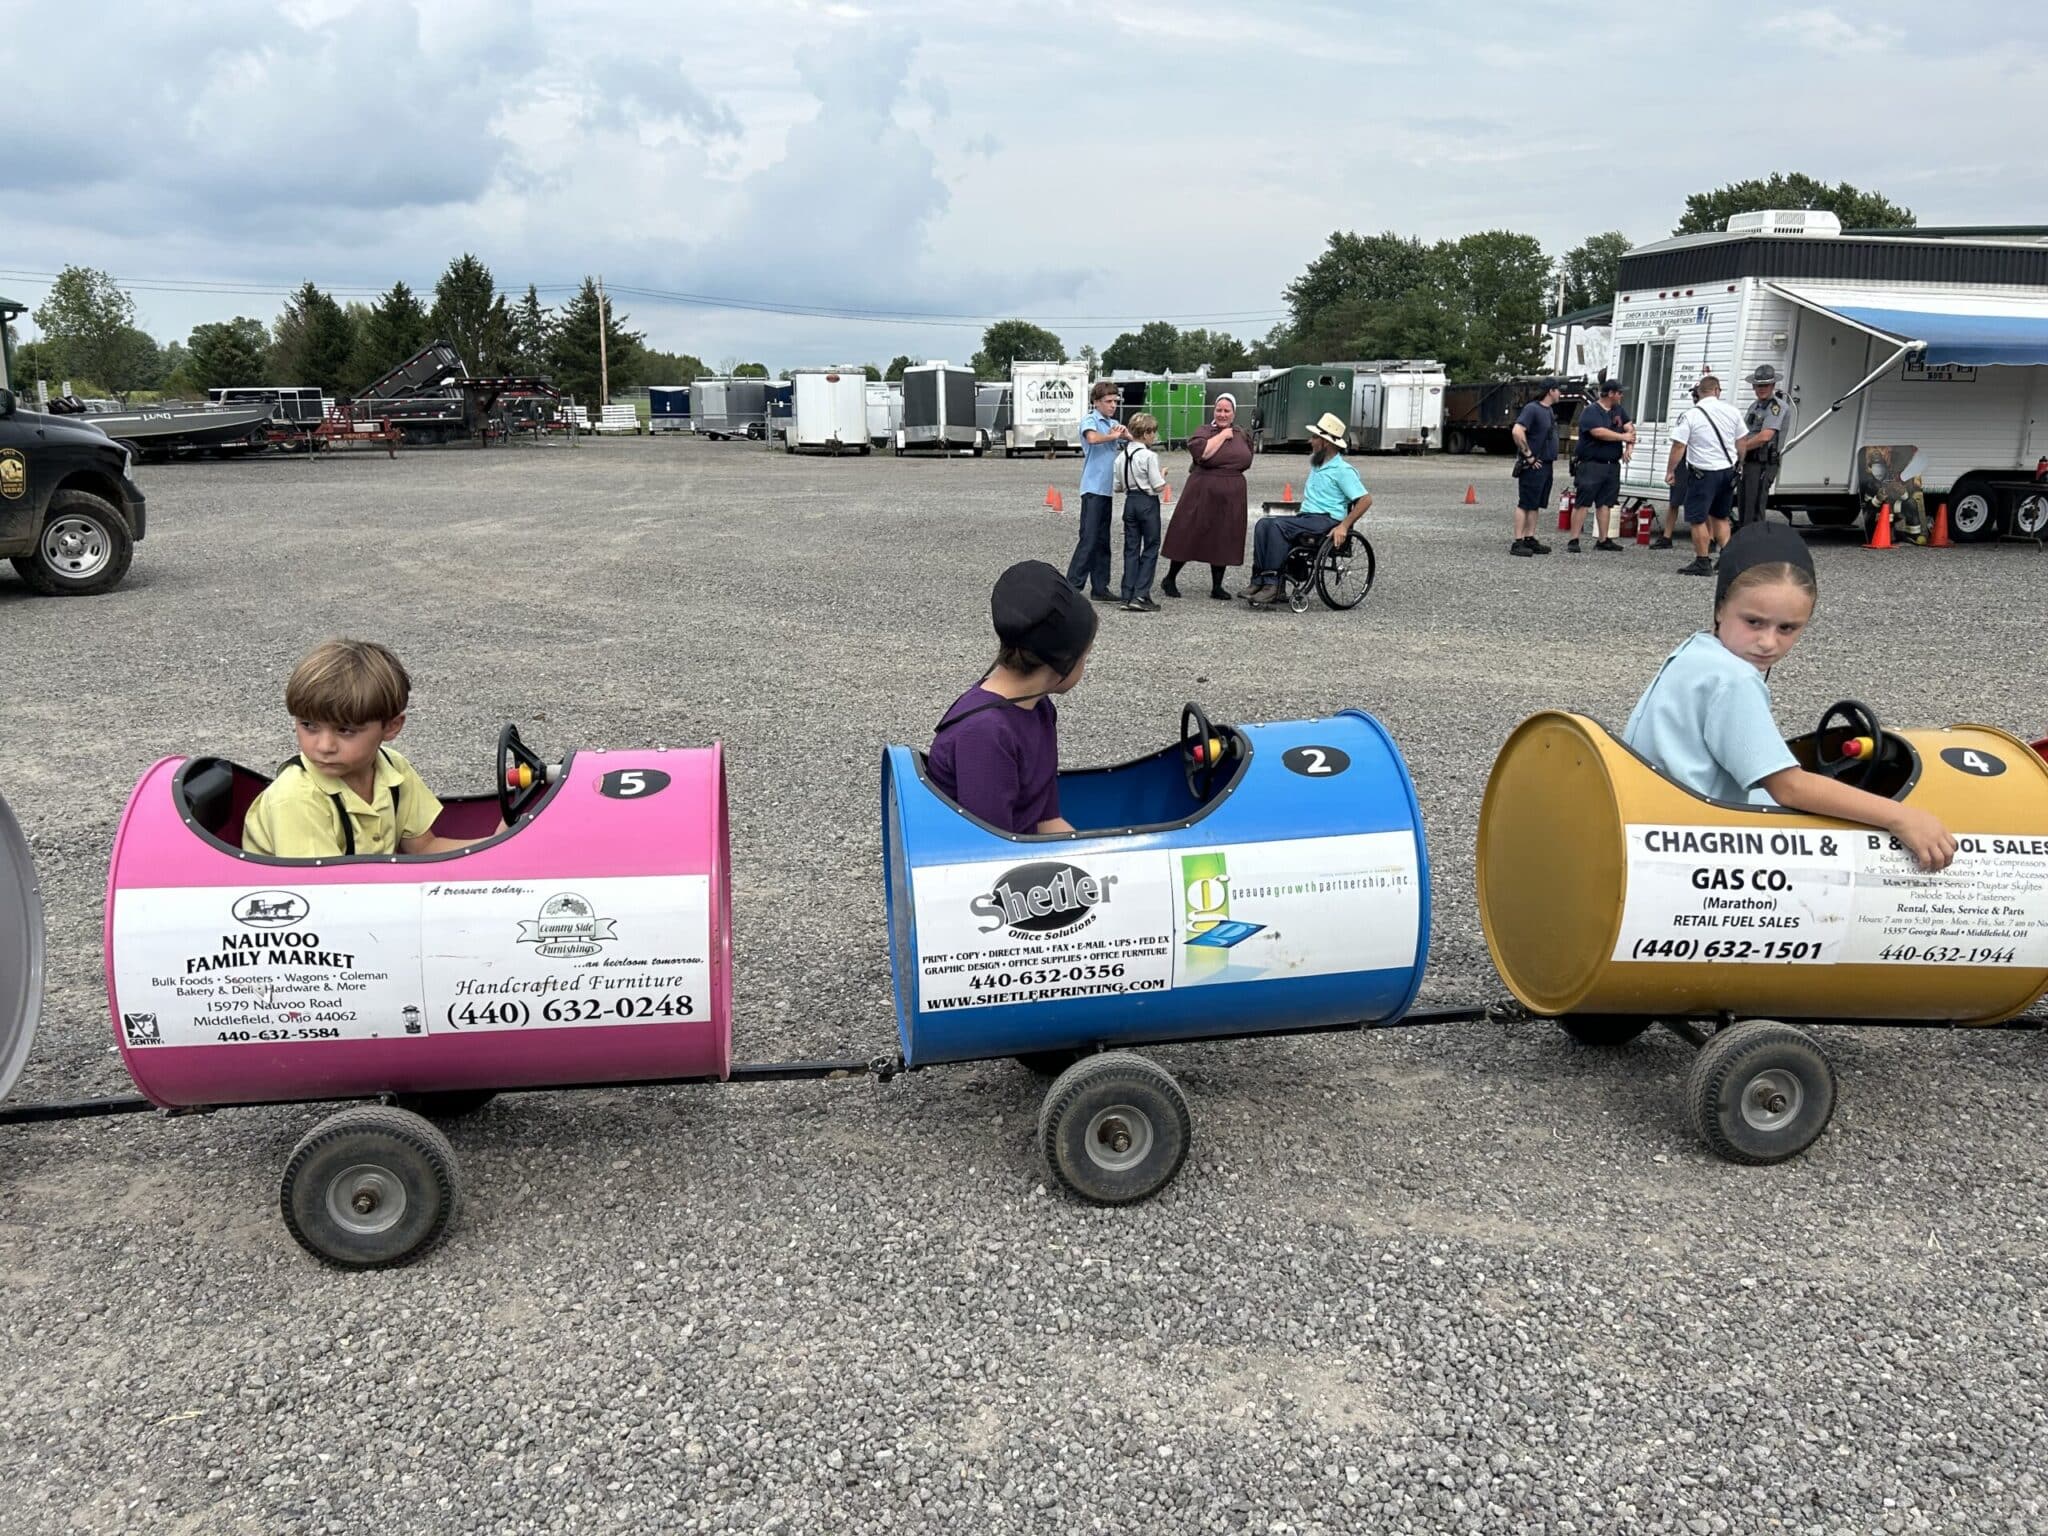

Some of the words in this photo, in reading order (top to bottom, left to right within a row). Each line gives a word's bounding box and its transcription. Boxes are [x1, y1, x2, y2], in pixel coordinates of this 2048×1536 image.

[143, 412, 172, 421] LUND
[1301, 749, 1332, 773] 2
[1963, 751, 1990, 773] 4
[620, 771, 646, 795] 5
[1645, 830, 1764, 855] CHAGRIN
[1770, 834, 1813, 856] OIL
[1819, 835, 1838, 856] &
[1868, 835, 1881, 850] B
[1888, 836, 1903, 850] &
[1691, 868, 1745, 890] GAS
[1751, 869, 1793, 891] CO.
[428, 886, 441, 896] A
[443, 886, 488, 895] treasure
[491, 885, 535, 896] today...
[969, 867, 1118, 934] Shetler
[1703, 897, 1777, 911] (Marathon)
[1897, 904, 1928, 914] Rental,
[1931, 904, 1955, 915] Sales,
[1957, 904, 1989, 915] Service
[1991, 906, 2000, 914] &
[2003, 905, 2025, 916] Parts
[575, 922, 593, 932] Side
[1008, 929, 1042, 941] Office
[1044, 914, 1097, 941] Solutions
[1673, 915, 1719, 927] RETAIL
[1722, 916, 1755, 927] FUEL
[1758, 917, 1800, 928] SALES
[222, 932, 319, 951] NAUVOO
[1908, 928, 1938, 937] Georgia
[1939, 928, 1960, 936] Road
[541, 944, 595, 956] Furnishings
[922, 954, 947, 964] PRINT
[956, 951, 980, 961] COPY
[988, 947, 1021, 958] DIRECT
[1022, 945, 1044, 955] MAIL
[1052, 943, 1069, 953] FAX
[1077, 941, 1106, 951] E-MAIL
[1114, 938, 1131, 947] UPS
[1139, 936, 1156, 945] FED
[1158, 935, 1169, 944] EX
[1632, 939, 1699, 960] (440)
[1704, 940, 1823, 960] 632-1501
[1878, 944, 2016, 963] 440-632-1944
[186, 950, 261, 974] FAMILY
[268, 950, 355, 969] MARKET
[602, 958, 648, 968] heirloom
[651, 957, 704, 966] tomorrow.
[924, 964, 966, 976] GRAPHIC
[967, 961, 1000, 972] DESIGN
[1008, 957, 1039, 968] OFFICE
[1040, 954, 1082, 966] SUPPLIES
[1089, 950, 1123, 961] OFFICE
[1124, 947, 1168, 958] FURNITURE
[151, 976, 176, 987] Bulk
[179, 975, 214, 986] Foods
[225, 974, 273, 985] Scooters
[284, 973, 329, 984] Wagons
[340, 971, 388, 981] Coleman
[455, 974, 585, 997] Handcrafted
[588, 973, 683, 990] Furniture
[969, 963, 1125, 990] 440-632-0356
[176, 987, 214, 999] Bakery
[218, 985, 228, 995] &
[232, 984, 253, 995] Deli
[265, 983, 320, 994] Hardware
[323, 982, 333, 991] &
[337, 981, 366, 992] More
[927, 978, 1165, 1010] WWW.SHETLERPRINTING.COM
[206, 1000, 249, 1013] 15979
[253, 999, 306, 1011] Nauvoo
[310, 998, 343, 1009] Road
[447, 1000, 530, 1029] (440)
[542, 994, 694, 1022] 632-0248
[193, 1013, 275, 1027] Middlefield,
[315, 1010, 357, 1022] 44062
[217, 1027, 340, 1042] 440-632-5584
